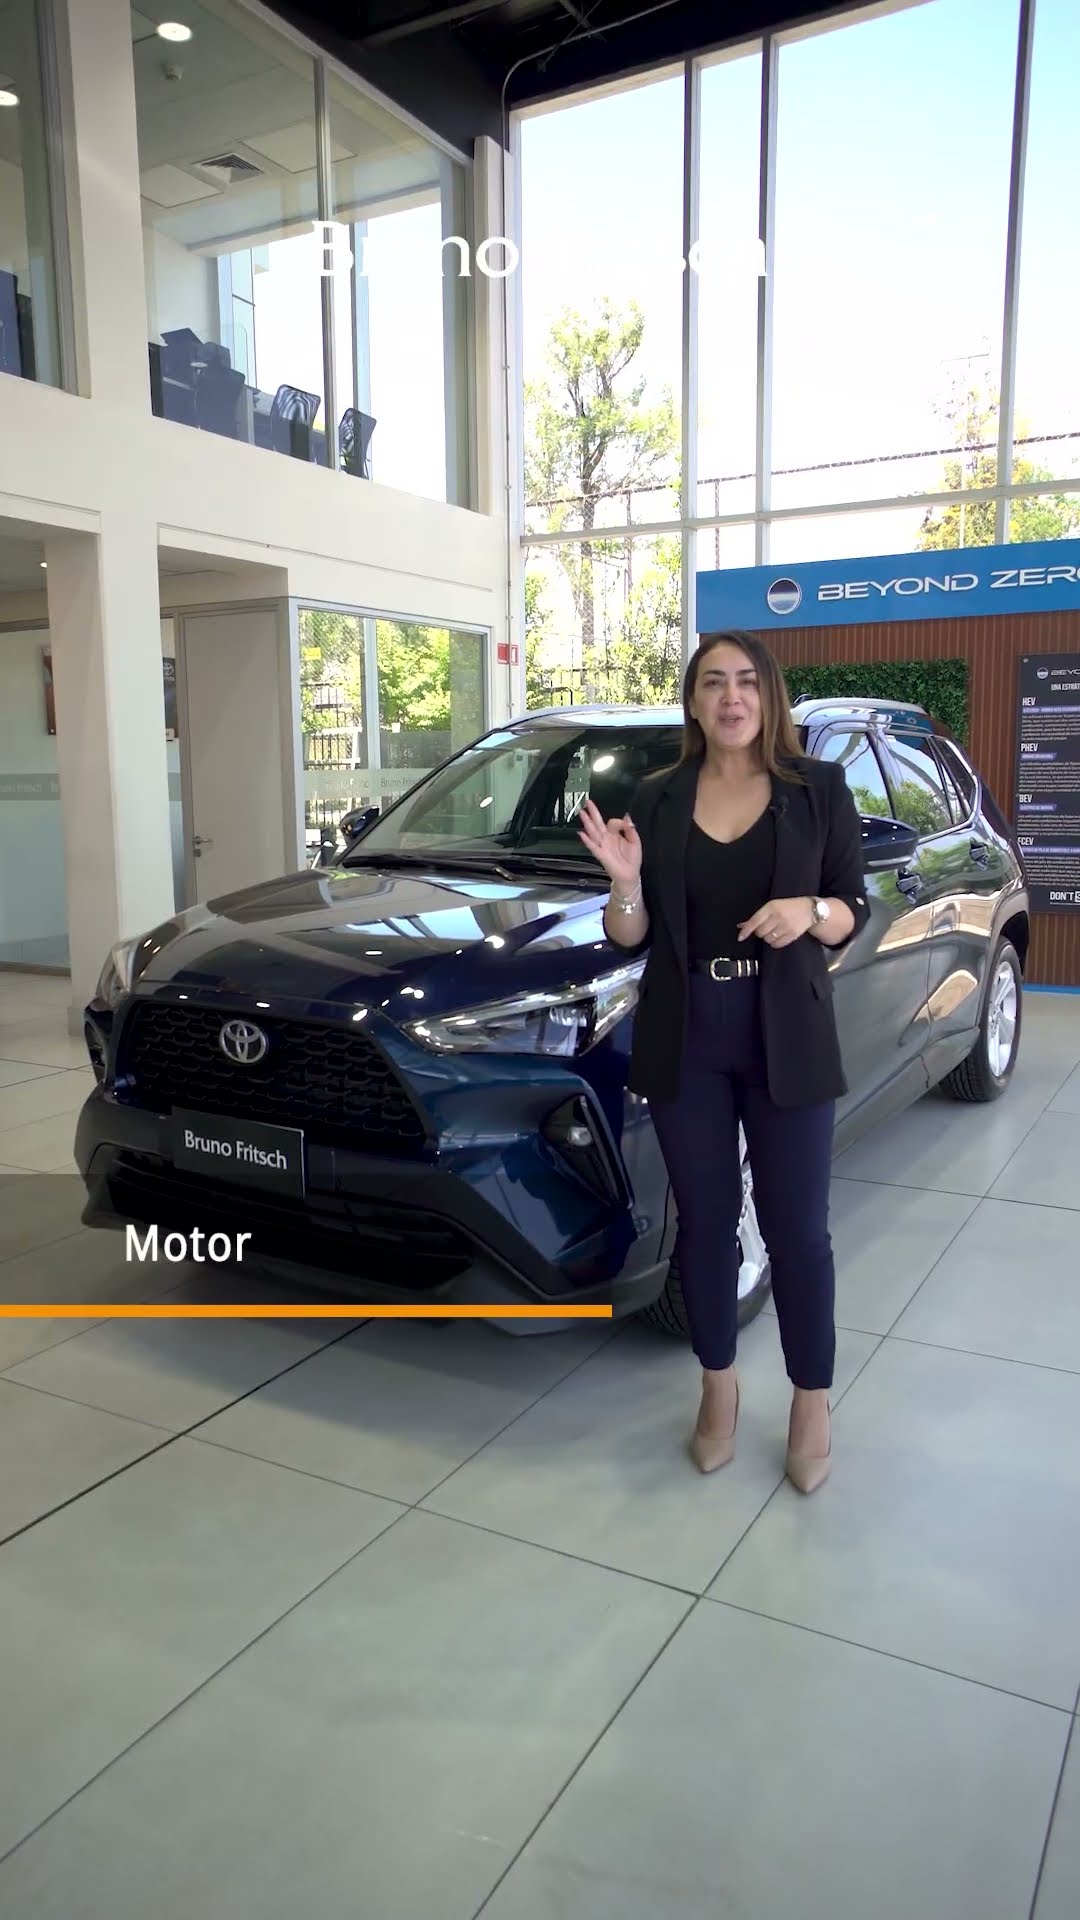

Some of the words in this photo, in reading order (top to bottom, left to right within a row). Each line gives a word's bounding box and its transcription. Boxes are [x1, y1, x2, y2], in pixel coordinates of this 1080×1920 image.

[818, 574, 979, 601] BEYOND
[990, 566, 1080, 588] ZER
[1022, 697, 1036, 706] HEV
[1020, 743, 1038, 752] PHEV
[1019, 794, 1032, 803] BEV
[1017, 836, 1034, 846] FCEV
[1049, 891, 1075, 901] DON'T
[184, 1129, 232, 1157] Bruno
[236, 1140, 287, 1170] Fritsch
